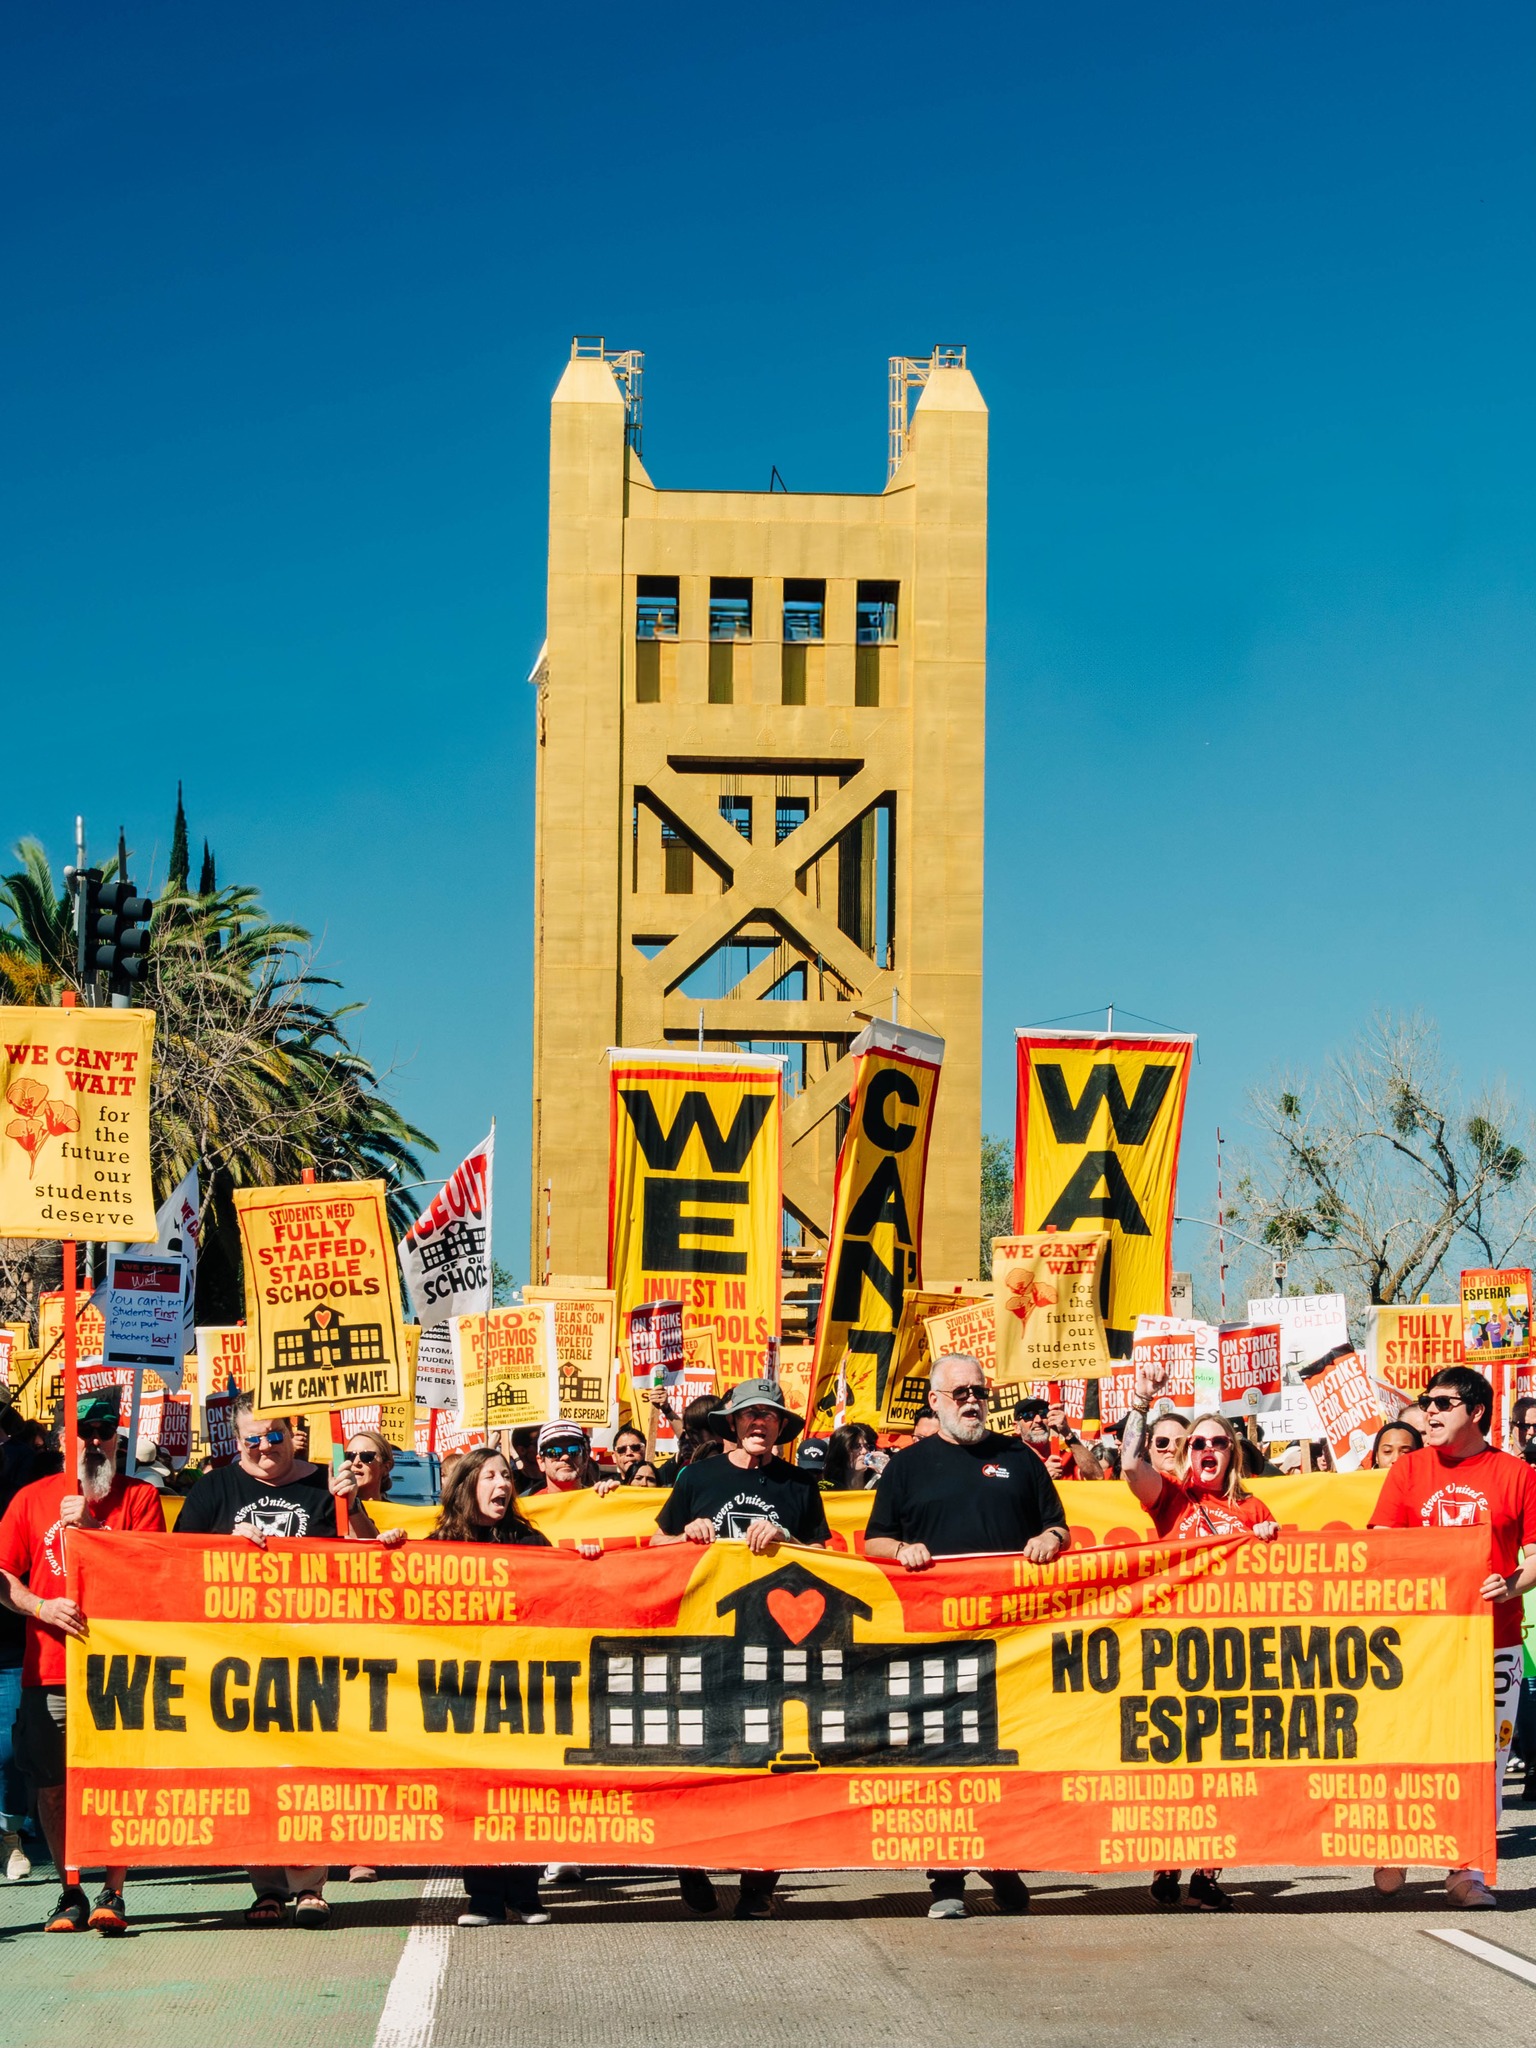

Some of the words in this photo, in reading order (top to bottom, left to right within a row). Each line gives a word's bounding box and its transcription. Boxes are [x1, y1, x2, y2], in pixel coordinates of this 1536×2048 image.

[4, 1044, 48, 1065] WE
[55, 1046, 138, 1072] CAN'T
[65, 1071, 136, 1096] WAIT
[99, 1106, 130, 1123] for
[95, 1126, 129, 1143] the
[61, 1143, 130, 1163] future
[94, 1169, 131, 1184] our
[618, 1090, 775, 1275] WE
[35, 1184, 132, 1203] students
[41, 1205, 134, 1225] deserve
[269, 1206, 323, 1226] STUDENTS
[326, 1203, 354, 1219] NEED
[274, 1219, 351, 1243] FULLY
[259, 1239, 375, 1265] STAFFED,
[1003, 1245, 1033, 1259] WE
[1040, 1243, 1098, 1258] CAN'T
[270, 1259, 361, 1284] STABLE
[441, 1260, 458, 1272] OF
[1047, 1261, 1097, 1275] WAIT
[266, 1278, 380, 1305] SCHOOLS
[1072, 1282, 1094, 1293] for
[1462, 1277, 1476, 1289] NO
[1479, 1273, 1526, 1287] PODEMOS
[110, 1291, 132, 1306] You
[137, 1296, 165, 1306] can't
[643, 1278, 716, 1308] INVEST
[724, 1281, 746, 1310] IN
[1069, 1297, 1094, 1308] the
[1463, 1286, 1511, 1301] ESPERAR
[112, 1306, 152, 1317] Students
[1250, 1294, 1343, 1317] PROTECT
[120, 1320, 136, 1329] you
[479, 1313, 523, 1332] NO
[588, 1313, 605, 1324] CON
[632, 1317, 647, 1333] ON
[648, 1312, 681, 1331] STRIKE
[945, 1311, 980, 1330] STUDENTS
[949, 1318, 996, 1340] FULLY
[1046, 1312, 1094, 1323] future
[1398, 1314, 1453, 1339] FULLY
[110, 1331, 149, 1342] teachers
[472, 1328, 537, 1352] PODEMOS
[633, 1332, 657, 1350] FOR
[660, 1328, 683, 1346] OUR
[940, 1331, 996, 1356] STAFFE
[1068, 1328, 1094, 1337] our
[418, 1346, 452, 1354] NATOM
[633, 1344, 684, 1366] STUDENTS
[1027, 1341, 1096, 1353] students
[1134, 1346, 1151, 1362] ON
[1153, 1343, 1194, 1360] STRIKE
[1221, 1340, 1237, 1356] ON
[1239, 1333, 1278, 1353] STRIKE
[1386, 1339, 1463, 1364] STAFFED
[476, 1347, 535, 1370] ESPERAR
[1032, 1357, 1097, 1369] deserve
[1165, 1360, 1194, 1379] OUR
[1224, 1355, 1249, 1374] FOR
[1251, 1349, 1279, 1370] OUR
[79, 1371, 114, 1388] STRIKE
[417, 1366, 455, 1375] DESERV
[1223, 1365, 1280, 1391] STUDENTS
[270, 1379, 292, 1401] WE
[298, 1375, 339, 1398] CAN'T
[344, 1370, 388, 1394] WAIT!
[676, 1382, 712, 1396] STRIKE
[1101, 1391, 1125, 1407] FOR
[1318, 1393, 1345, 1426] FOR
[164, 1416, 187, 1431] OUR
[207, 1408, 223, 1423] ON
[574, 1408, 605, 1419] ESPERAR
[890, 1407, 902, 1419] NO
[258, 1496, 301, 1510] United
[734, 1492, 775, 1512] United
[1421, 1489, 1445, 1517] Rivers
[1445, 1482, 1484, 1499] United
[45, 1548, 61, 1576] Twin
[203, 1550, 292, 1583] INVEST
[301, 1553, 327, 1584] IN
[334, 1551, 383, 1584] THE
[391, 1552, 509, 1587] SCHOOLS
[1014, 1550, 1129, 1587] INVIERTA
[1138, 1550, 1170, 1577] EN
[1178, 1546, 1228, 1576] LAS
[1236, 1541, 1368, 1575] ESCUELAS
[204, 1586, 257, 1619] OUR
[263, 1587, 395, 1619] STUDENTS
[403, 1589, 517, 1621] DESERVE
[942, 1596, 993, 1629] QUE
[1002, 1585, 1133, 1624] NUESTROS
[1142, 1580, 1314, 1615] ESTUDIANTES
[1323, 1577, 1447, 1612] MERECEN
[1051, 1626, 1121, 1693] NO
[1141, 1625, 1404, 1692] PODEMOS
[87, 1654, 187, 1732] WE
[210, 1656, 397, 1733] CAN'T
[417, 1658, 581, 1735] WAIT
[1120, 1694, 1359, 1763] ESPERAR
[276, 1784, 389, 1812] STABILITY
[396, 1784, 438, 1811] FOR
[849, 1778, 952, 1805] ESCUELAS
[959, 1777, 1001, 1804] CON
[1062, 1774, 1194, 1802] ESTABILIDAD
[1202, 1771, 1258, 1798] PARA
[1308, 1773, 1387, 1800] SUELDO
[1394, 1773, 1460, 1800] JUSTO
[81, 1788, 148, 1816] FULLY
[155, 1788, 250, 1817] STAFFED
[487, 1788, 560, 1815] LIVING
[568, 1789, 633, 1816] WAGE
[278, 1815, 323, 1842] OUR
[330, 1814, 444, 1842] STUDENTS
[871, 1808, 978, 1834] PERSONAL
[1112, 1804, 1217, 1832] NUESTROS
[1334, 1803, 1389, 1830] PARA
[1396, 1803, 1436, 1831] LOS
[110, 1816, 214, 1847] SCHOOLS
[474, 1816, 516, 1842] FOR
[524, 1816, 655, 1844] EDUCATORS
[871, 1836, 985, 1862] COMPLETO
[1100, 1834, 1237, 1864] ESTUDIANTES
[1321, 1832, 1459, 1861] EDUCADORES
